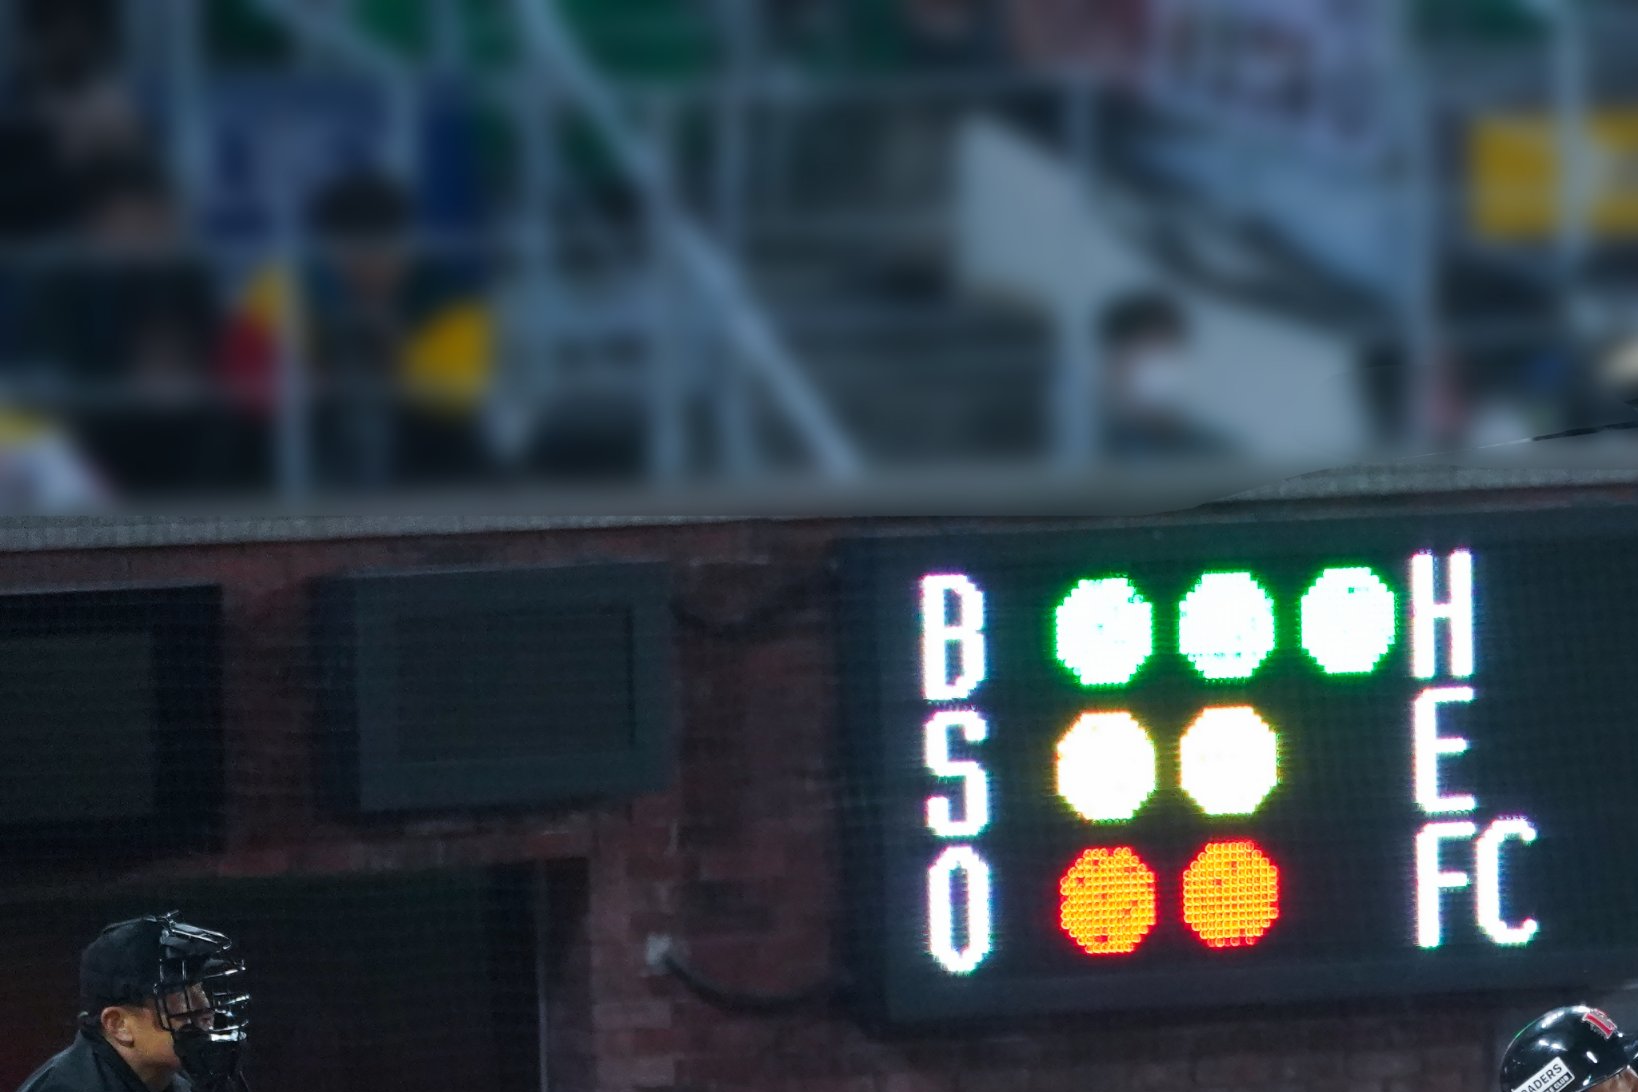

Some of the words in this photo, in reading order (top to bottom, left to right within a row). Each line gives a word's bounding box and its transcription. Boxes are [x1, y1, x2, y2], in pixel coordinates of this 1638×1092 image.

[920, 572, 989, 701] B
[1410, 549, 1475, 679] H
[923, 708, 991, 838] S
[1412, 686, 1476, 815] E
[1416, 815, 1540, 949] FC
